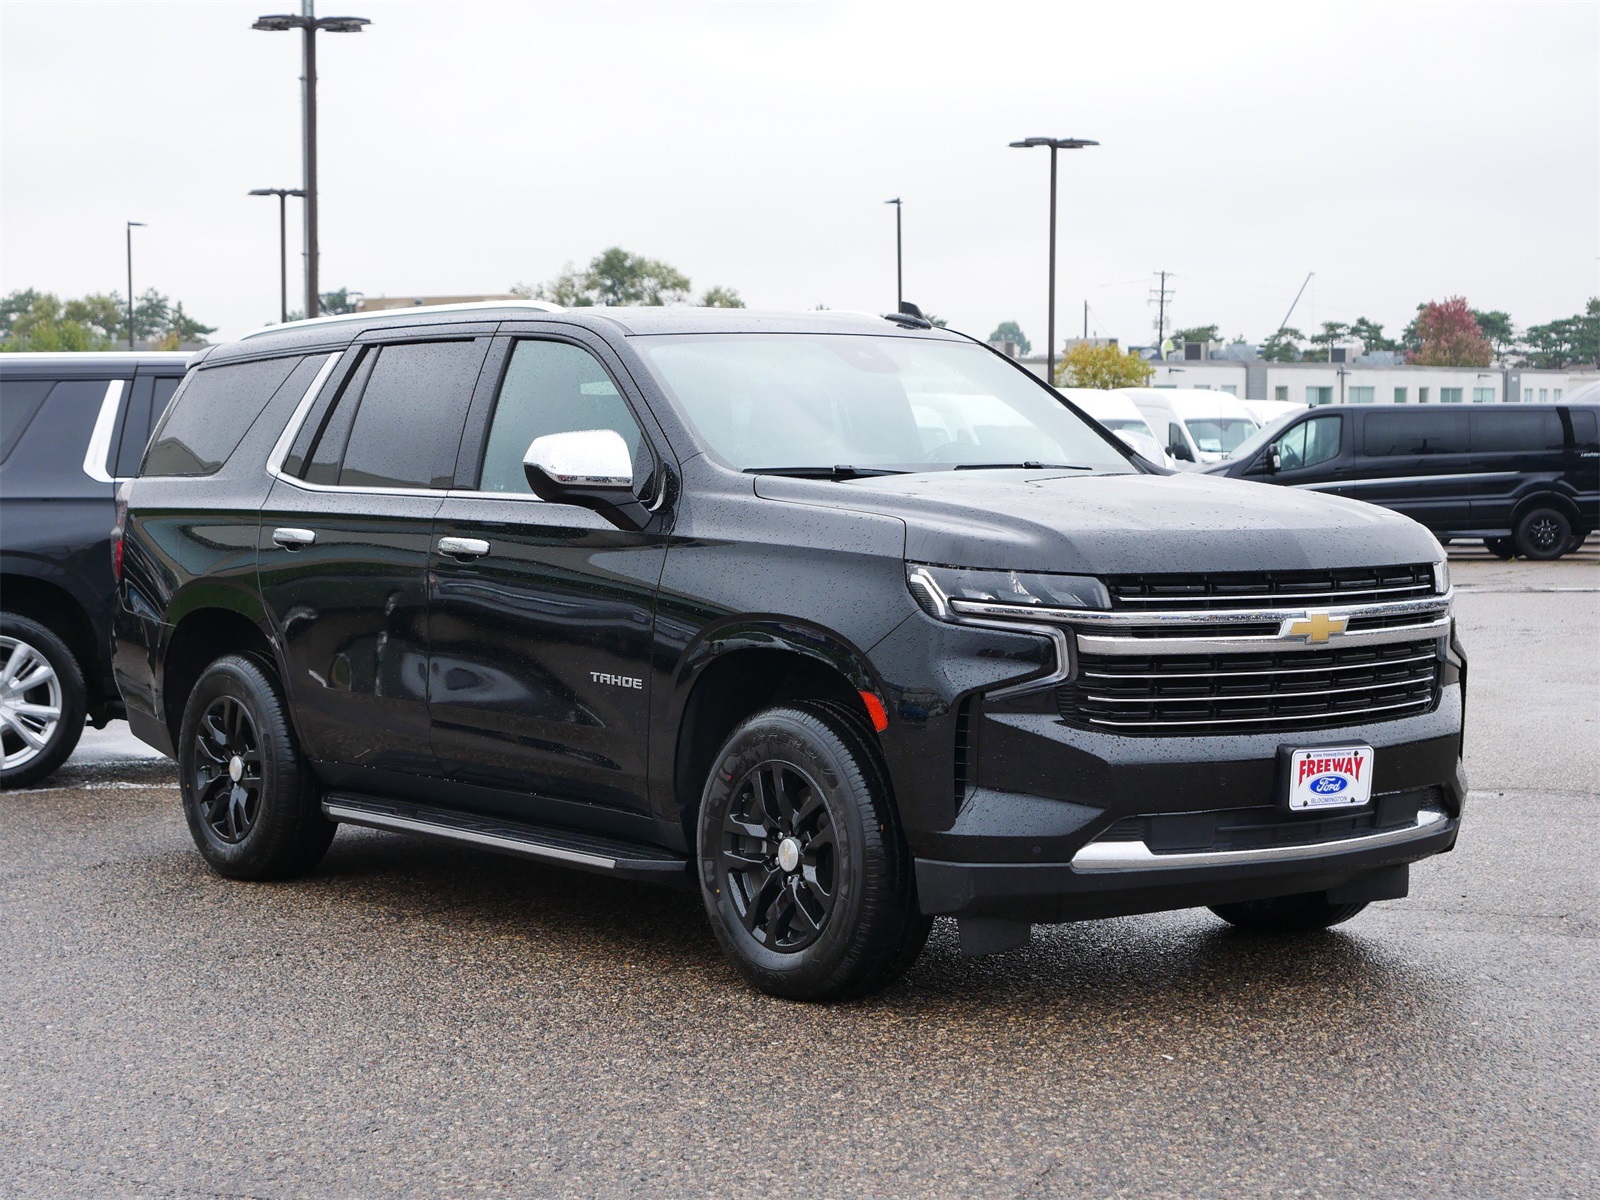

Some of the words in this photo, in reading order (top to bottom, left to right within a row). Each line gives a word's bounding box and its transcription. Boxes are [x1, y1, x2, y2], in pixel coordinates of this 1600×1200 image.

[590, 671, 643, 690] TAHOE
[1298, 756, 1364, 787] FREEWAY
[1316, 777, 1341, 792] Ford
[1310, 796, 1348, 804] BLOOMINGTON
